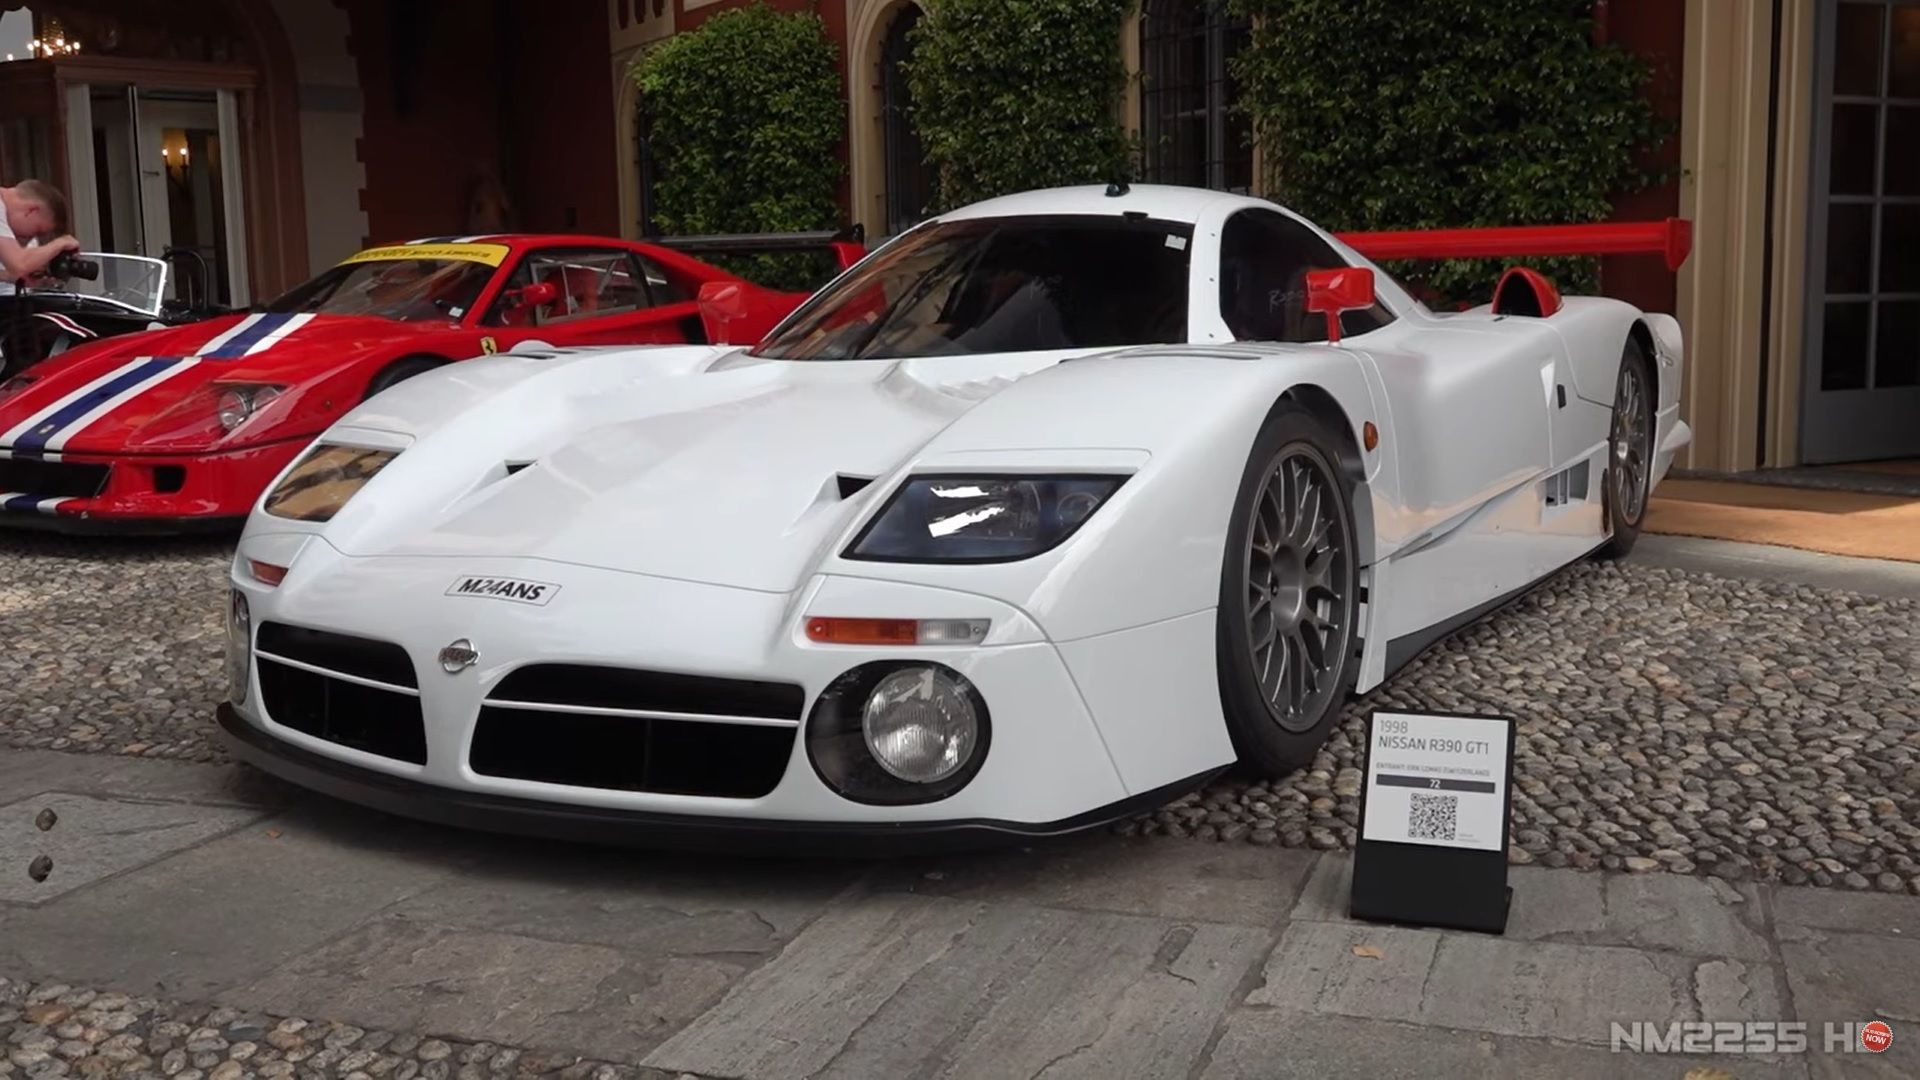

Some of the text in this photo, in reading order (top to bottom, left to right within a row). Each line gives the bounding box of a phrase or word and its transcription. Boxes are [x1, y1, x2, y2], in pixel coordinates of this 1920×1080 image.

[1380, 719, 1408, 734] 1998
[1378, 735, 1489, 755] NISSAN R390 GT1
[1429, 779, 1441, 790] 72
